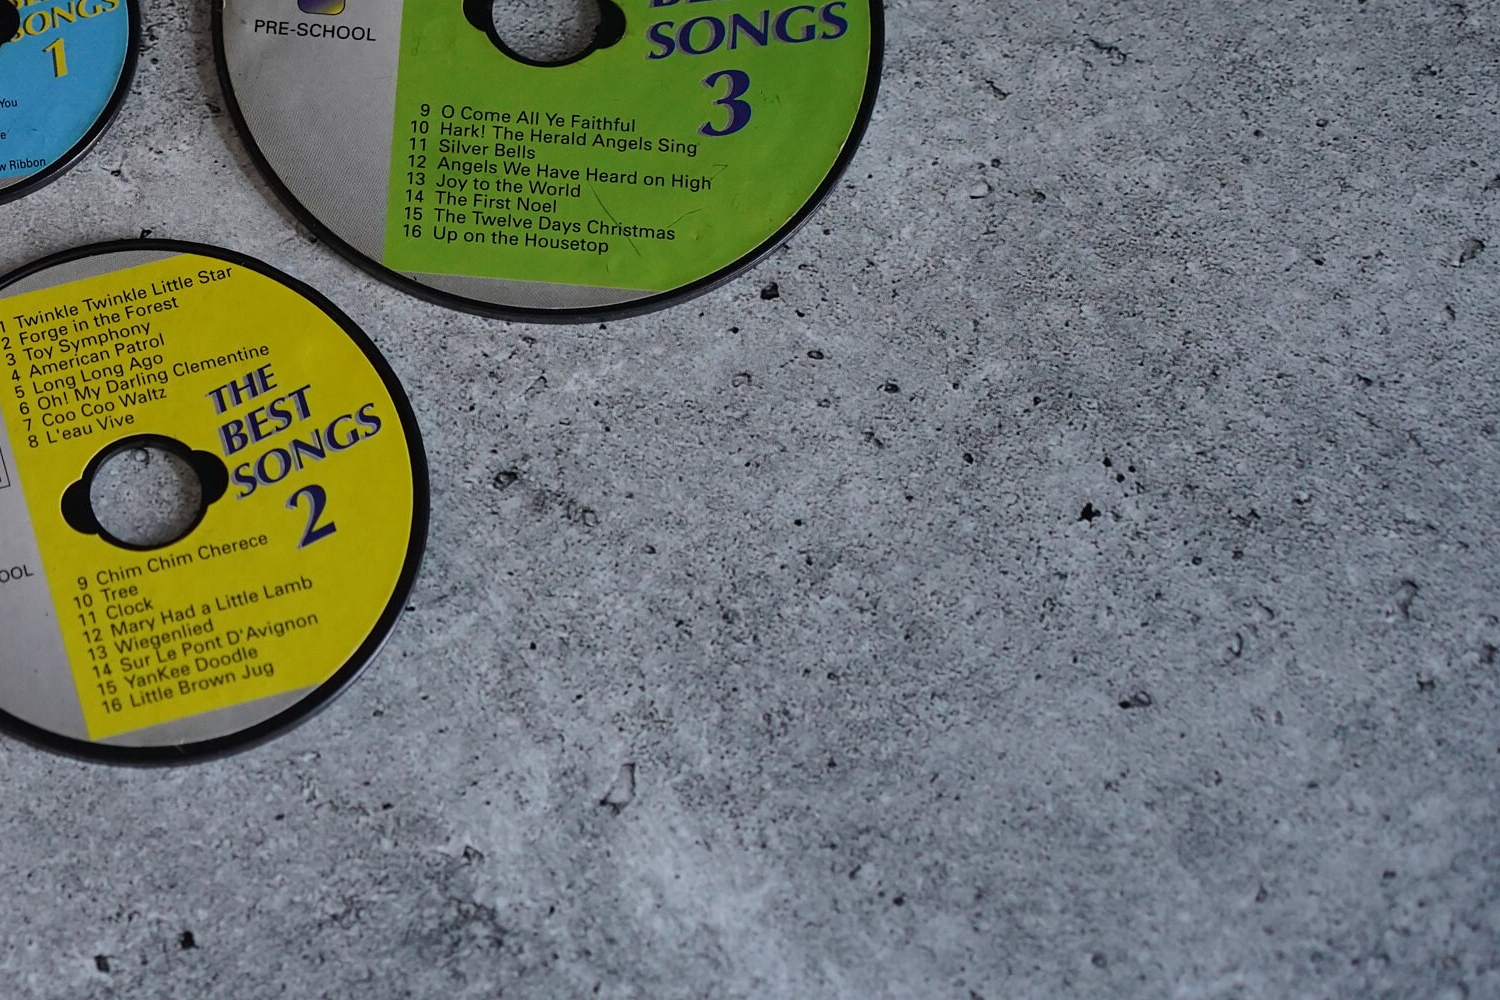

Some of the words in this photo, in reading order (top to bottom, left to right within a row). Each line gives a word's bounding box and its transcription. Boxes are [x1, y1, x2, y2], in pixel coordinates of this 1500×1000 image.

[254, 19, 377, 41] PRE-SCHOOL
[645, 1, 848, 60] SONGS
[42, 37, 68, 78] 1
[420, 103, 431, 117] 9
[441, 104, 455, 119] O
[460, 106, 511, 123] Come
[515, 110, 539, 125] All
[545, 112, 565, 128] Ye
[571, 114, 636, 132] Faithful
[698, 69, 752, 137] 3
[409, 137, 426, 151] 11
[439, 138, 489, 156] Silver
[494, 143, 536, 160] Bells
[410, 120, 429, 134] 10
[440, 121, 485, 138] Hark!
[491, 125, 524, 142] The
[530, 128, 587, 146] Herald
[591, 133, 653, 152] Angels
[658, 138, 697, 157] Sing
[407, 171, 426, 186] 13
[435, 173, 468, 192] Joy
[473, 178, 490, 191] to
[495, 178, 523, 194] the
[528, 180, 581, 198] World
[408, 154, 427, 169] 12
[437, 156, 498, 175] Angels
[503, 161, 531, 177] We
[536, 163, 580, 181] Have
[586, 167, 638, 185] Heard
[643, 175, 665, 187] on
[671, 174, 711, 193] High
[405, 188, 424, 203] 14
[435, 190, 468, 207] The
[473, 193, 511, 210] First
[517, 197, 557, 213] Noel
[403, 223, 422, 238] 16
[433, 225, 458, 244] Up
[463, 231, 485, 243] on
[491, 230, 519, 246] the
[525, 233, 609, 255] Housetop
[13, 305, 79, 329] Twinkle
[81, 288, 147, 312] Twinkle
[151, 276, 194, 296] Little
[197, 267, 232, 284] Star
[1, 336, 12, 351] 2
[18, 325, 68, 346] Forge
[72, 319, 89, 333] in
[93, 312, 121, 328] the
[124, 297, 179, 319] Forest
[5, 352, 17, 367] 3
[22, 346, 53, 361] Toy
[58, 322, 150, 353] Symphony
[11, 369, 21, 382] 4
[29, 350, 110, 378] American
[114, 333, 165, 357] Patrol
[14, 385, 26, 399] 5
[32, 375, 77, 395] Long
[80, 364, 124, 383] Long
[129, 354, 164, 371] Ago
[19, 401, 30, 415] 6
[37, 391, 69, 411] Oh!
[73, 386, 101, 402] My
[105, 370, 169, 394] Darling
[172, 345, 269, 377] Clementine
[205, 363, 278, 415] THE
[22, 417, 32, 432] 7
[41, 411, 76, 427] Coo
[80, 401, 115, 417] Coo
[118, 388, 167, 408] Waltz
[27, 434, 39, 449] 8
[46, 424, 93, 444] L'eau
[96, 414, 135, 431] Vive
[218, 384, 312, 457] BEST
[230, 402, 382, 500] SONGS
[285, 484, 337, 550] 2
[77, 576, 88, 591] 9
[96, 566, 143, 586] Chim
[147, 553, 193, 573] Chim
[73, 593, 93, 609] 10
[99, 585, 139, 602] Tree
[78, 610, 97, 627] 11
[105, 597, 154, 620] Clock
[87, 645, 108, 661] 13
[114, 618, 214, 654] Wiegenlied
[97, 680, 118, 696] 15
[194, 647, 258, 672] Doodle
[101, 697, 123, 714] 16
[129, 687, 174, 708] Little
[178, 672, 236, 695] Brown
[241, 662, 275, 680] Jug
